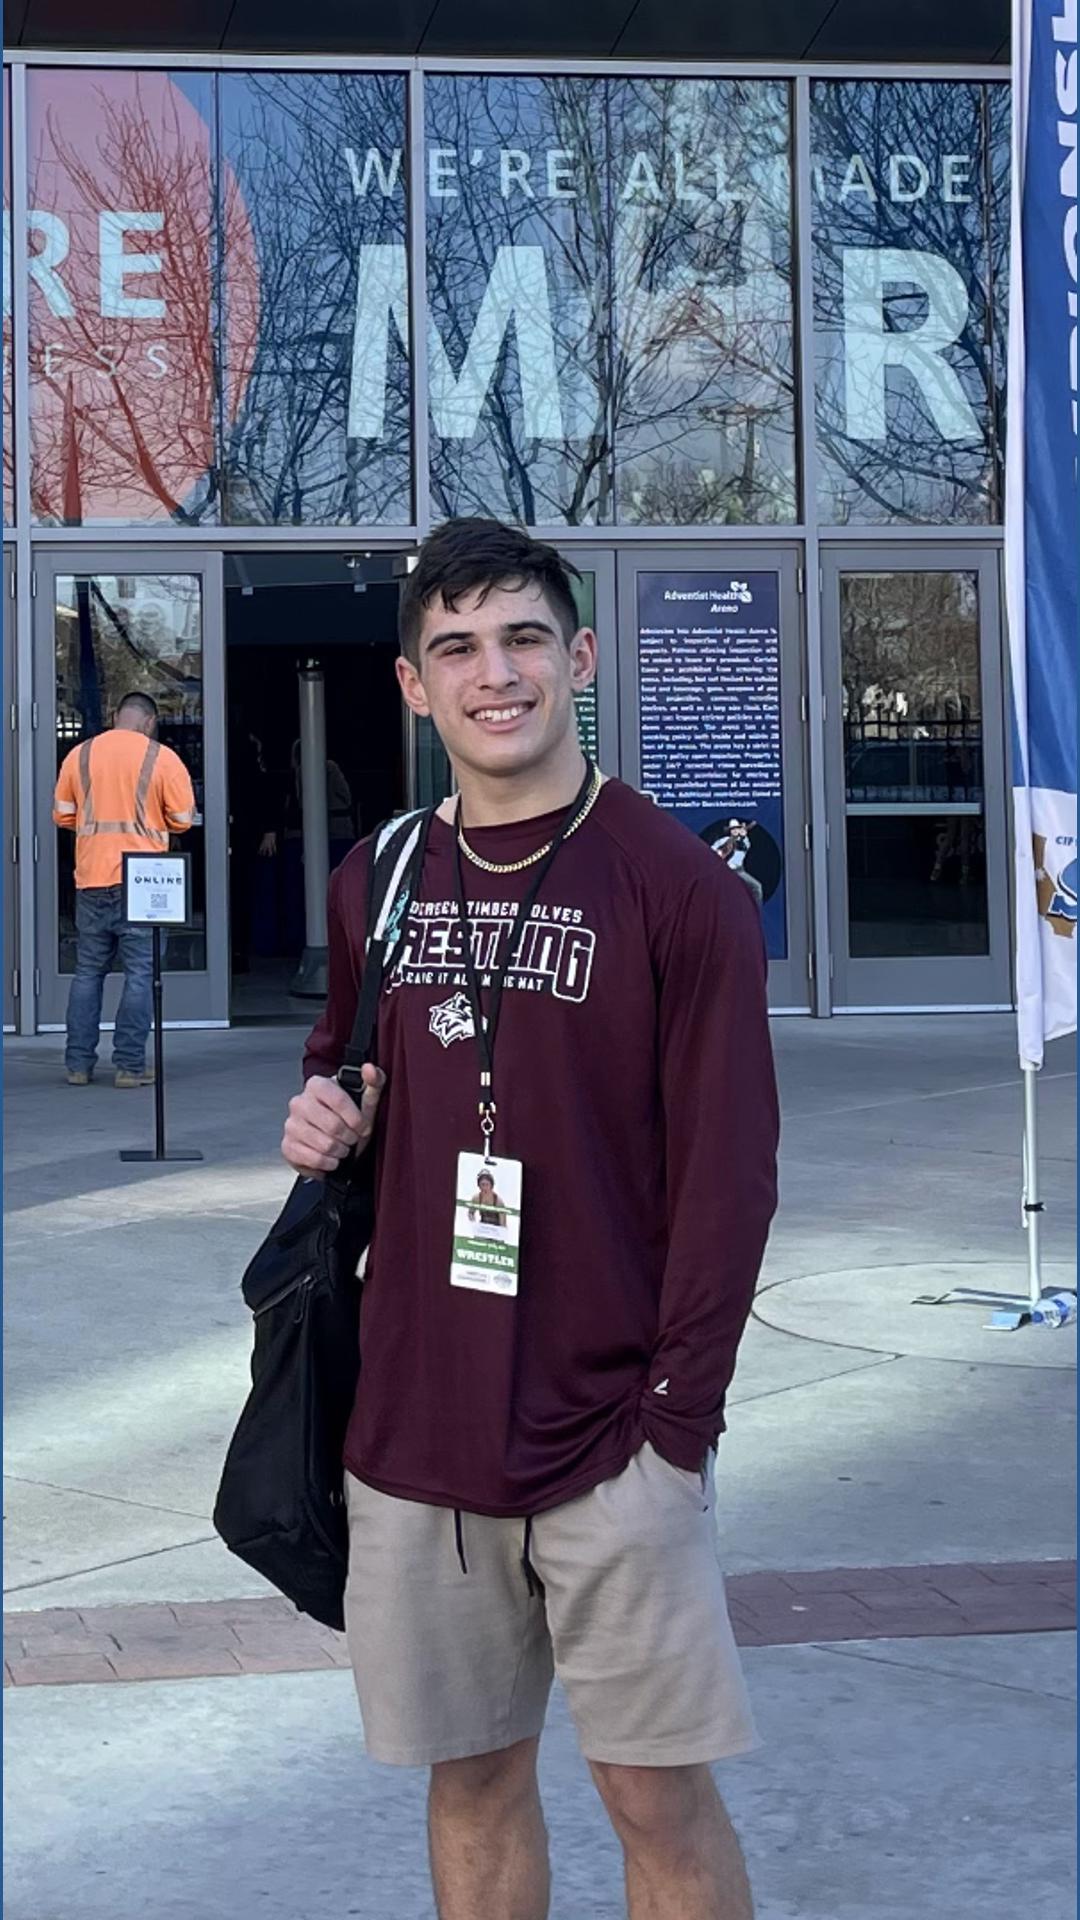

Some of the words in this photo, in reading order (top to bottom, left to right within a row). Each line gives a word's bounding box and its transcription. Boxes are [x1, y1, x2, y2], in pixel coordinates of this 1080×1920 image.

[344, 148, 577, 202] WE'RE
[622, 151, 760, 202] ALL
[4, 343, 167, 379] ESS
[664, 590, 709, 600] Adventist
[710, 589, 740, 601] Health
[710, 604, 739, 613] Arena
[134, 876, 183, 884] ONLINE
[467, 901, 583, 923] TIMBEROLVES
[385, 917, 596, 1003] RESTLING
[518, 978, 545, 991] MAT
[457, 1248, 515, 1268] WRESTLER
